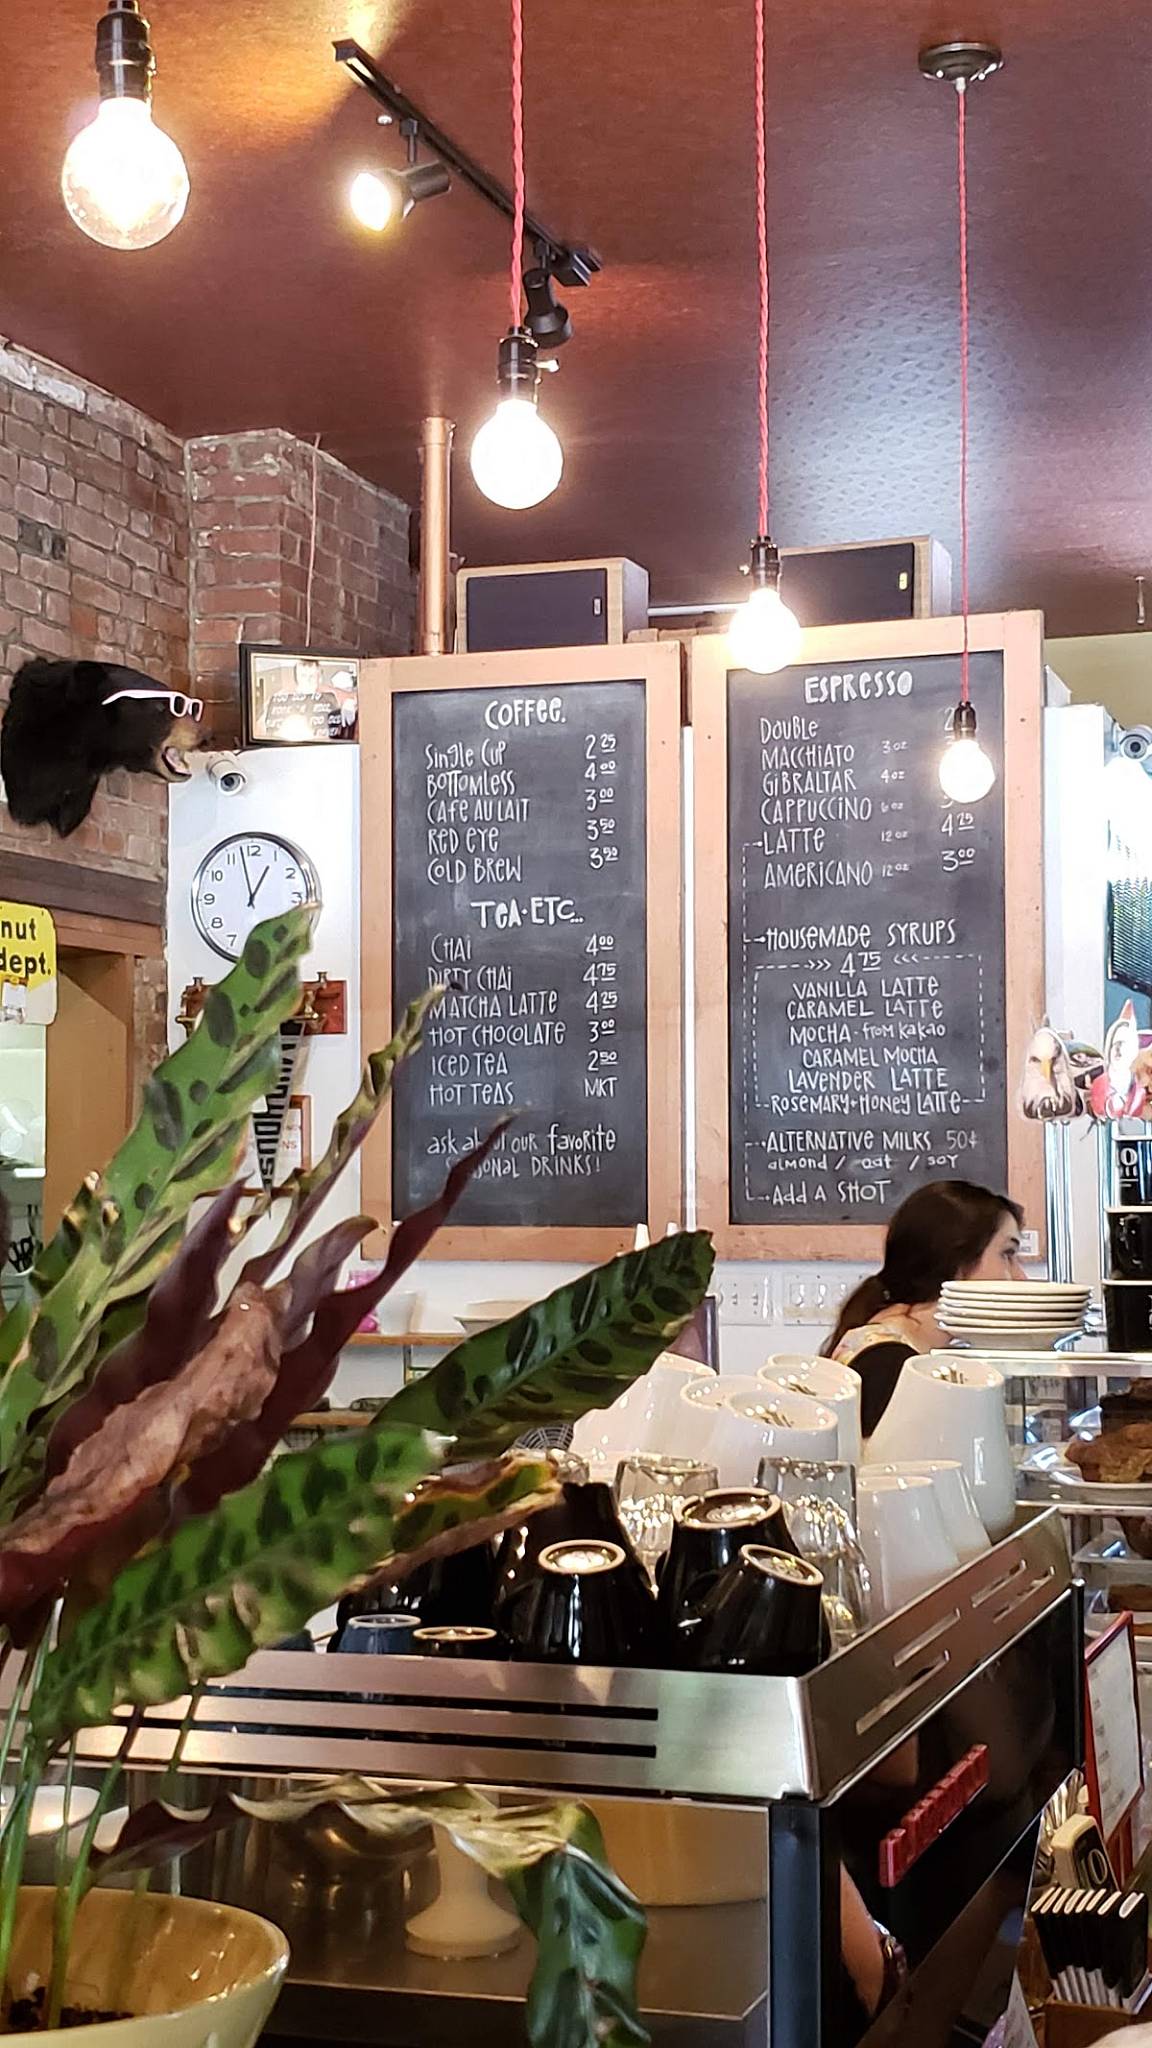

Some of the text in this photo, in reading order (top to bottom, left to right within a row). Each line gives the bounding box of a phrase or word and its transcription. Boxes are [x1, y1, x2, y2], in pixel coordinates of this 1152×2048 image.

[227, 853, 236, 865] 11
[246, 845, 262, 857] 12
[273, 850, 278, 862] 1
[211, 870, 223, 882] 10
[285, 868, 296, 879] 2
[203, 893, 216, 905] 9
[291, 892, 303, 904] 3
[211, 917, 223, 929] 8
[887, 918, 956, 946] SYRUPS
[226, 934, 237, 947] 7
[793, 980, 868, 999] VANILLA
[786, 1000, 874, 1021] CARAMEL
[428, 1026, 467, 1048] HOT
[790, 1024, 851, 1047] MOCHA
[802, 1046, 938, 1068] CARAMEL MOCHA
[584, 1077, 618, 1098] MKT
[891, 1068, 948, 1092] LATTE
[430, 1084, 468, 1106] HOT
[427, 1128, 458, 1154] ask
[882, 1131, 932, 1151] MILKS
[838, 1180, 892, 1203] SHOT
